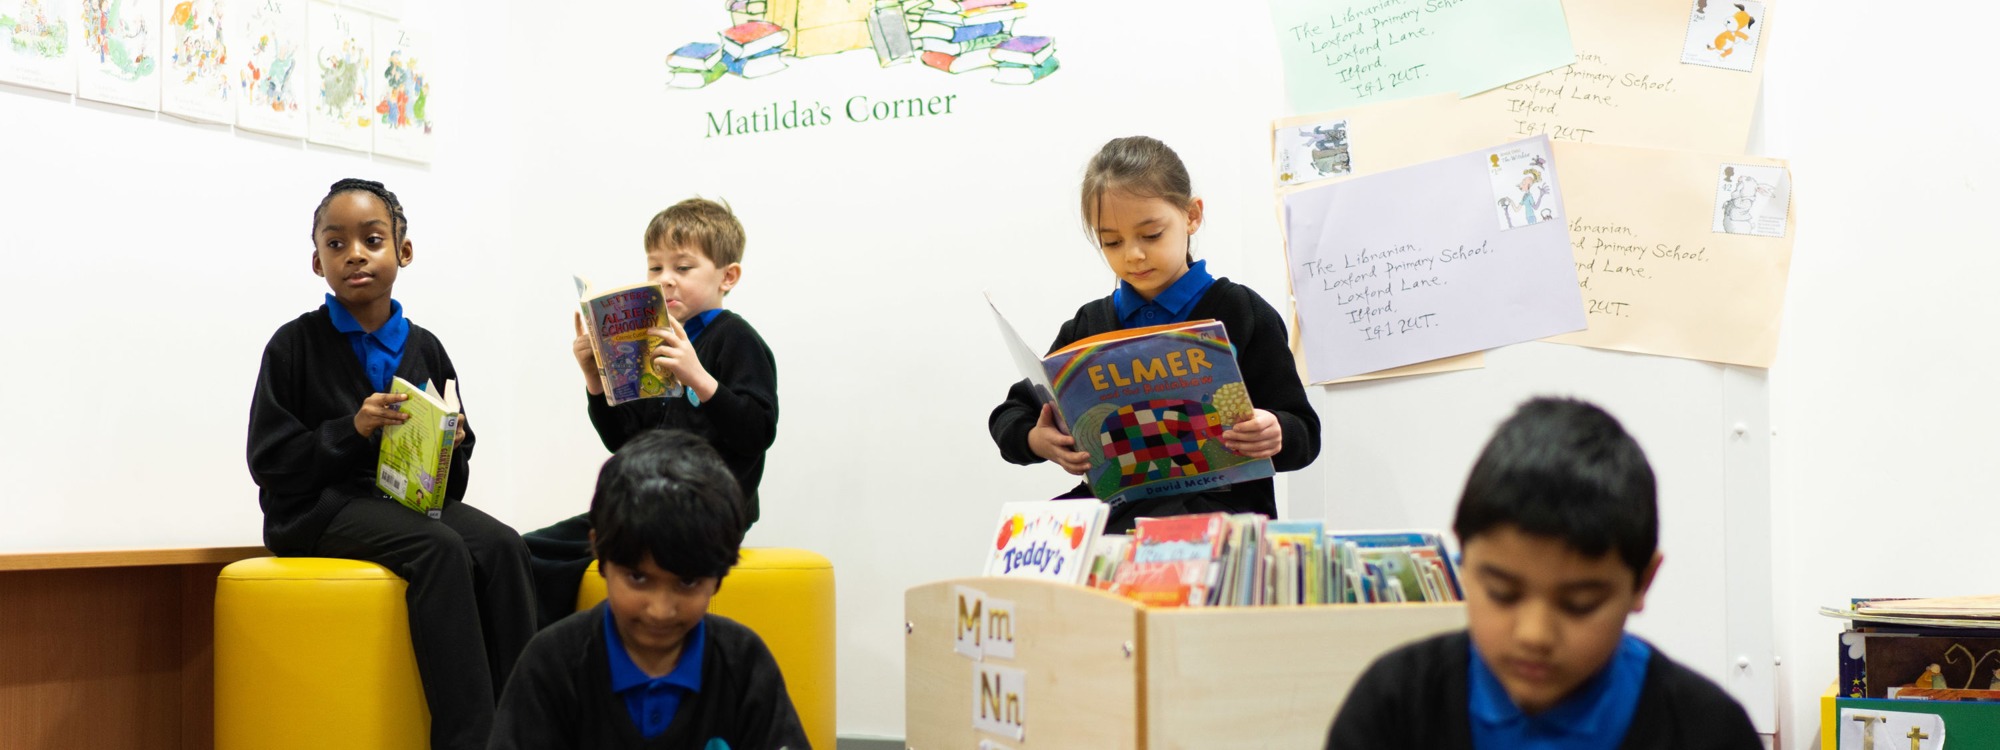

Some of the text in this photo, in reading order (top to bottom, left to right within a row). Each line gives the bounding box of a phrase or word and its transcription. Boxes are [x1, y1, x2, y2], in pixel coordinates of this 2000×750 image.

[1290, 22, 1322, 41] The
[1311, 22, 1364, 54] Loxford
[1371, 7, 1420, 34] Primary
[1326, 27, 1435, 66] Loxford Lane.
[1563, 64, 1676, 93] Primary School.
[1571, 86, 1618, 108] Lane.
[705, 93, 957, 138] Matilda's Corner
[1569, 216, 1637, 238] ibrarian.
[1302, 244, 1421, 278] The Librarian.
[1594, 238, 1647, 260] Primary
[1652, 243, 1709, 262] School.
[1323, 240, 1494, 291] Loxford Primary School.
[1603, 259, 1652, 279] Lane.
[600, 291, 649, 308] LETTERS
[1337, 276, 1447, 305] Loxford Lane.
[601, 316, 659, 337] SCHOOLBOY
[602, 307, 656, 325] ALIEN
[1087, 348, 1213, 392] ELMER
[1143, 374, 1213, 395] Rainbow
[447, 418, 455, 428] G
[1145, 473, 1225, 496] David McKee
[1003, 540, 1065, 576] Teddy's
